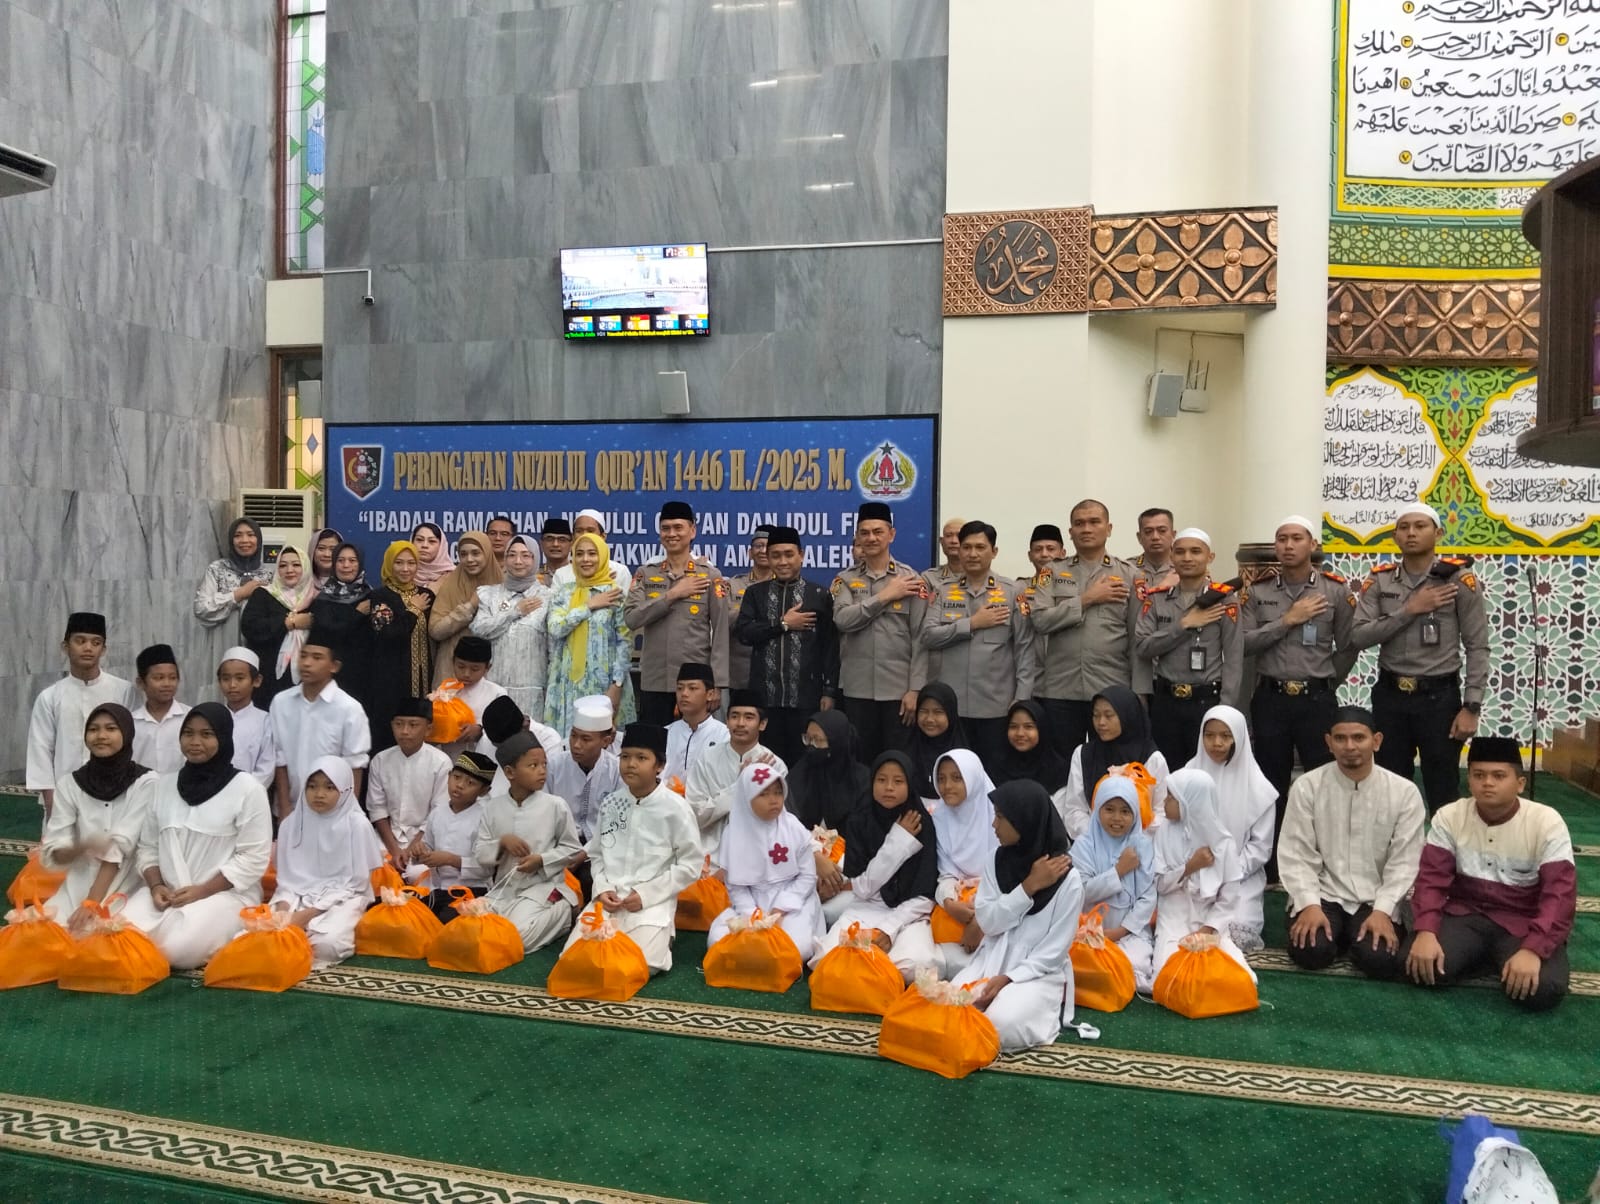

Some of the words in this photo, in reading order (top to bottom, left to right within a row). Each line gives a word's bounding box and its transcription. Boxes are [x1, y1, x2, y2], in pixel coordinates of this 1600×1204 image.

[393, 451, 507, 491] PERINGATAN
[512, 450, 590, 491] NUZULUL
[673, 450, 723, 491] 1446
[828, 448, 852, 491] M.
[562, 511, 647, 534] NULUL
[787, 512, 833, 536] IDUL
[802, 545, 854, 568] ALEH
